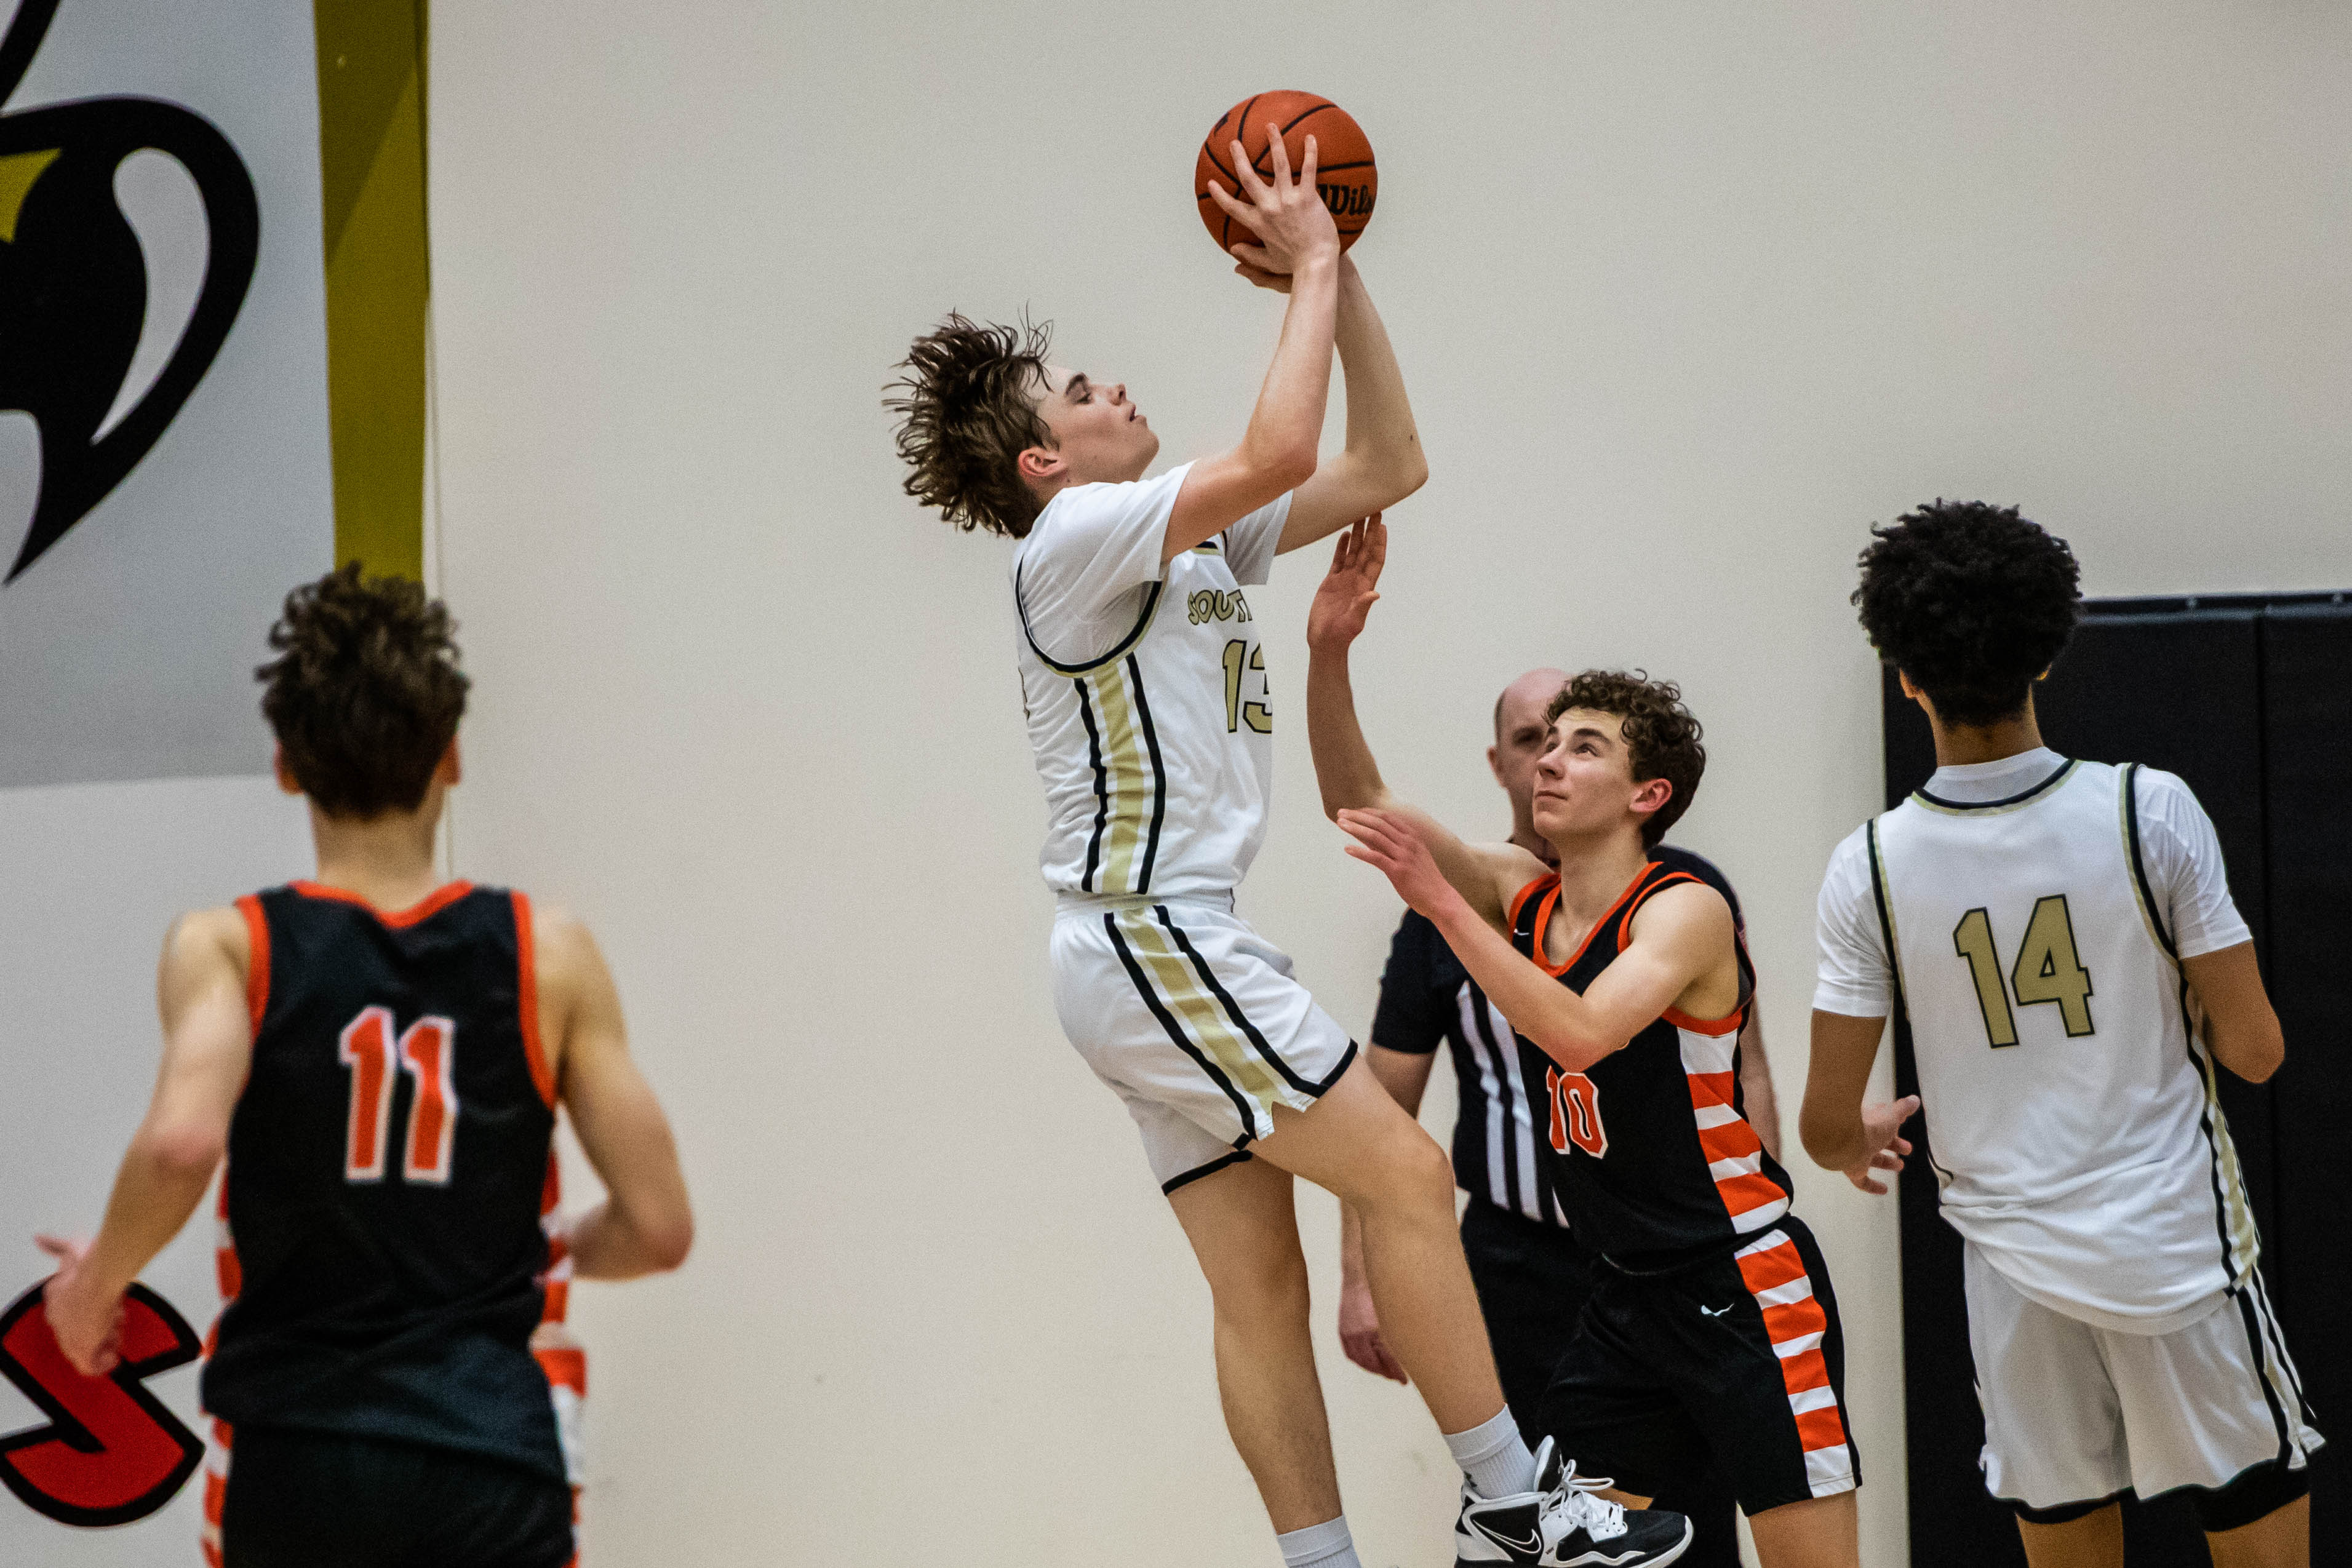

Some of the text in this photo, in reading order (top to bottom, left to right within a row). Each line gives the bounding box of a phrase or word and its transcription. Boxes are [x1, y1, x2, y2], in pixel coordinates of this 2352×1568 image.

[1187, 589, 1253, 625] SOUT
[1953, 894, 2095, 1049] 14
[339, 1005, 458, 1182] 11
[1546, 1065, 1608, 1159] 10
